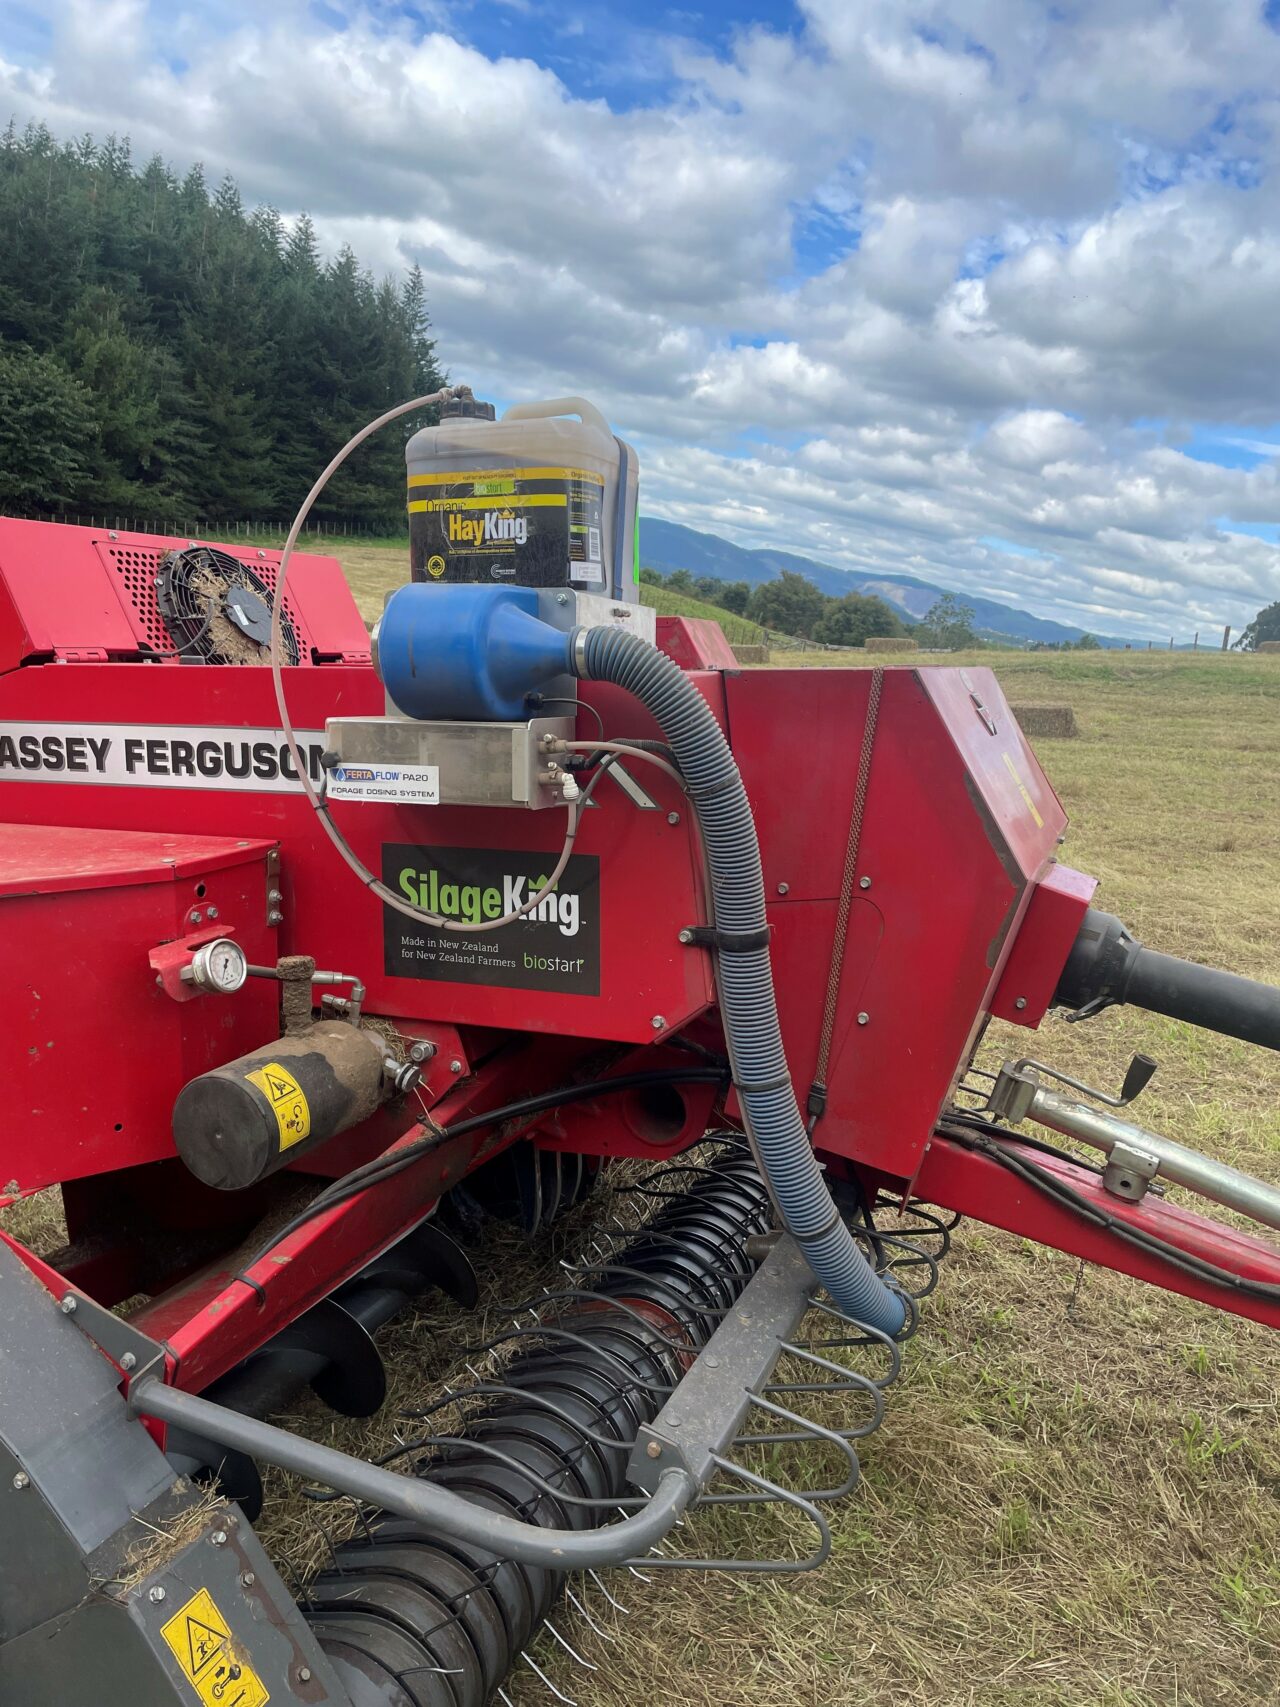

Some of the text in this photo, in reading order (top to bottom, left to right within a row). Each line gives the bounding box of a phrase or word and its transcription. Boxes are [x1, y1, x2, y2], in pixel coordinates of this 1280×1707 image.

[449, 512, 528, 545] HayKing
[402, 773, 429, 782] PA20
[331, 787, 435, 798] FORAGE DOSING SYSTEM
[399, 867, 580, 937] SilageKing
[401, 936, 499, 953] Made in New Zealand
[401, 948, 517, 968] for New Zealand Farmers
[523, 951, 581, 974] biostart
